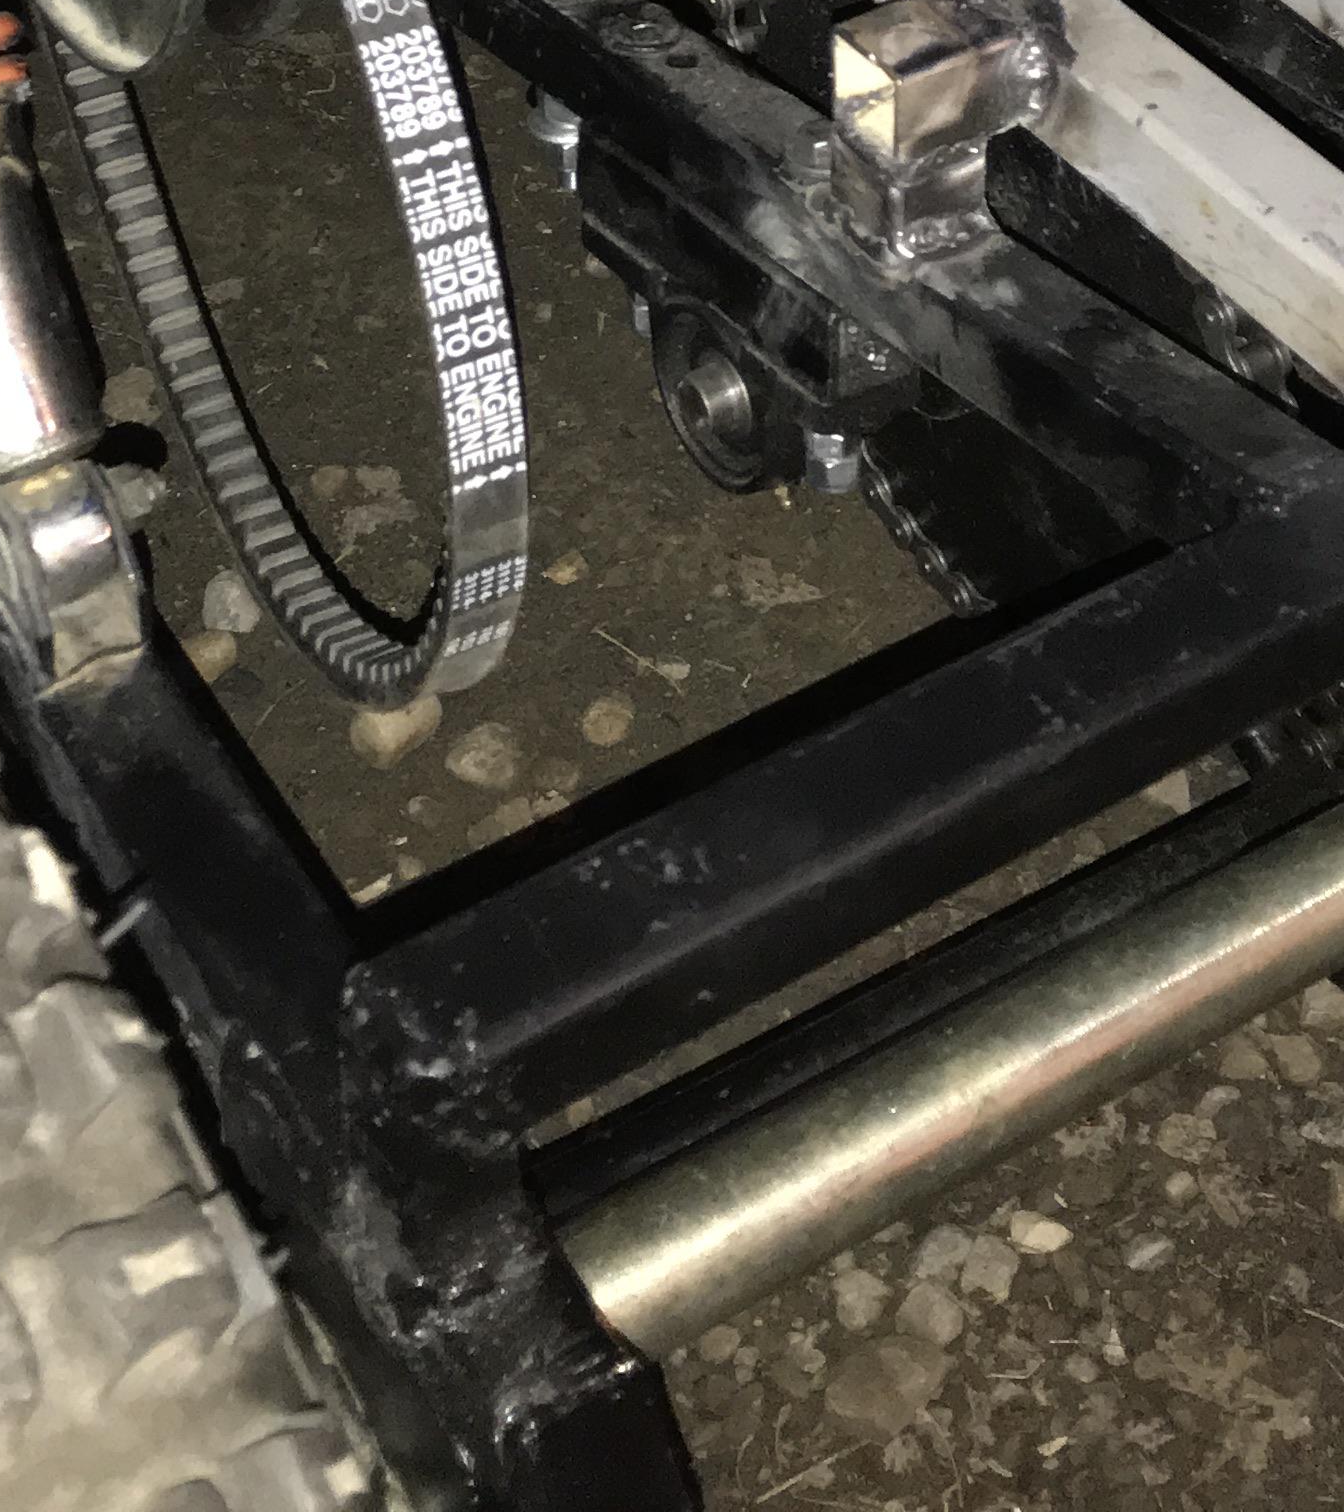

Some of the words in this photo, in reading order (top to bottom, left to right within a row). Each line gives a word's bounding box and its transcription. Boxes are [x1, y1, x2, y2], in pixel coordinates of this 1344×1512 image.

[368, 36, 422, 139] 203789
[395, 29, 448, 131] 203789
[409, 168, 447, 240] THIS
[436, 159, 473, 232] THIS
[427, 243, 464, 317] SIDE
[454, 235, 491, 308] SIDE
[442, 314, 470, 358] TO
[469, 305, 498, 349] TO
[449, 361, 487, 473] ENGINE
[476, 352, 512, 464] ENGINE
